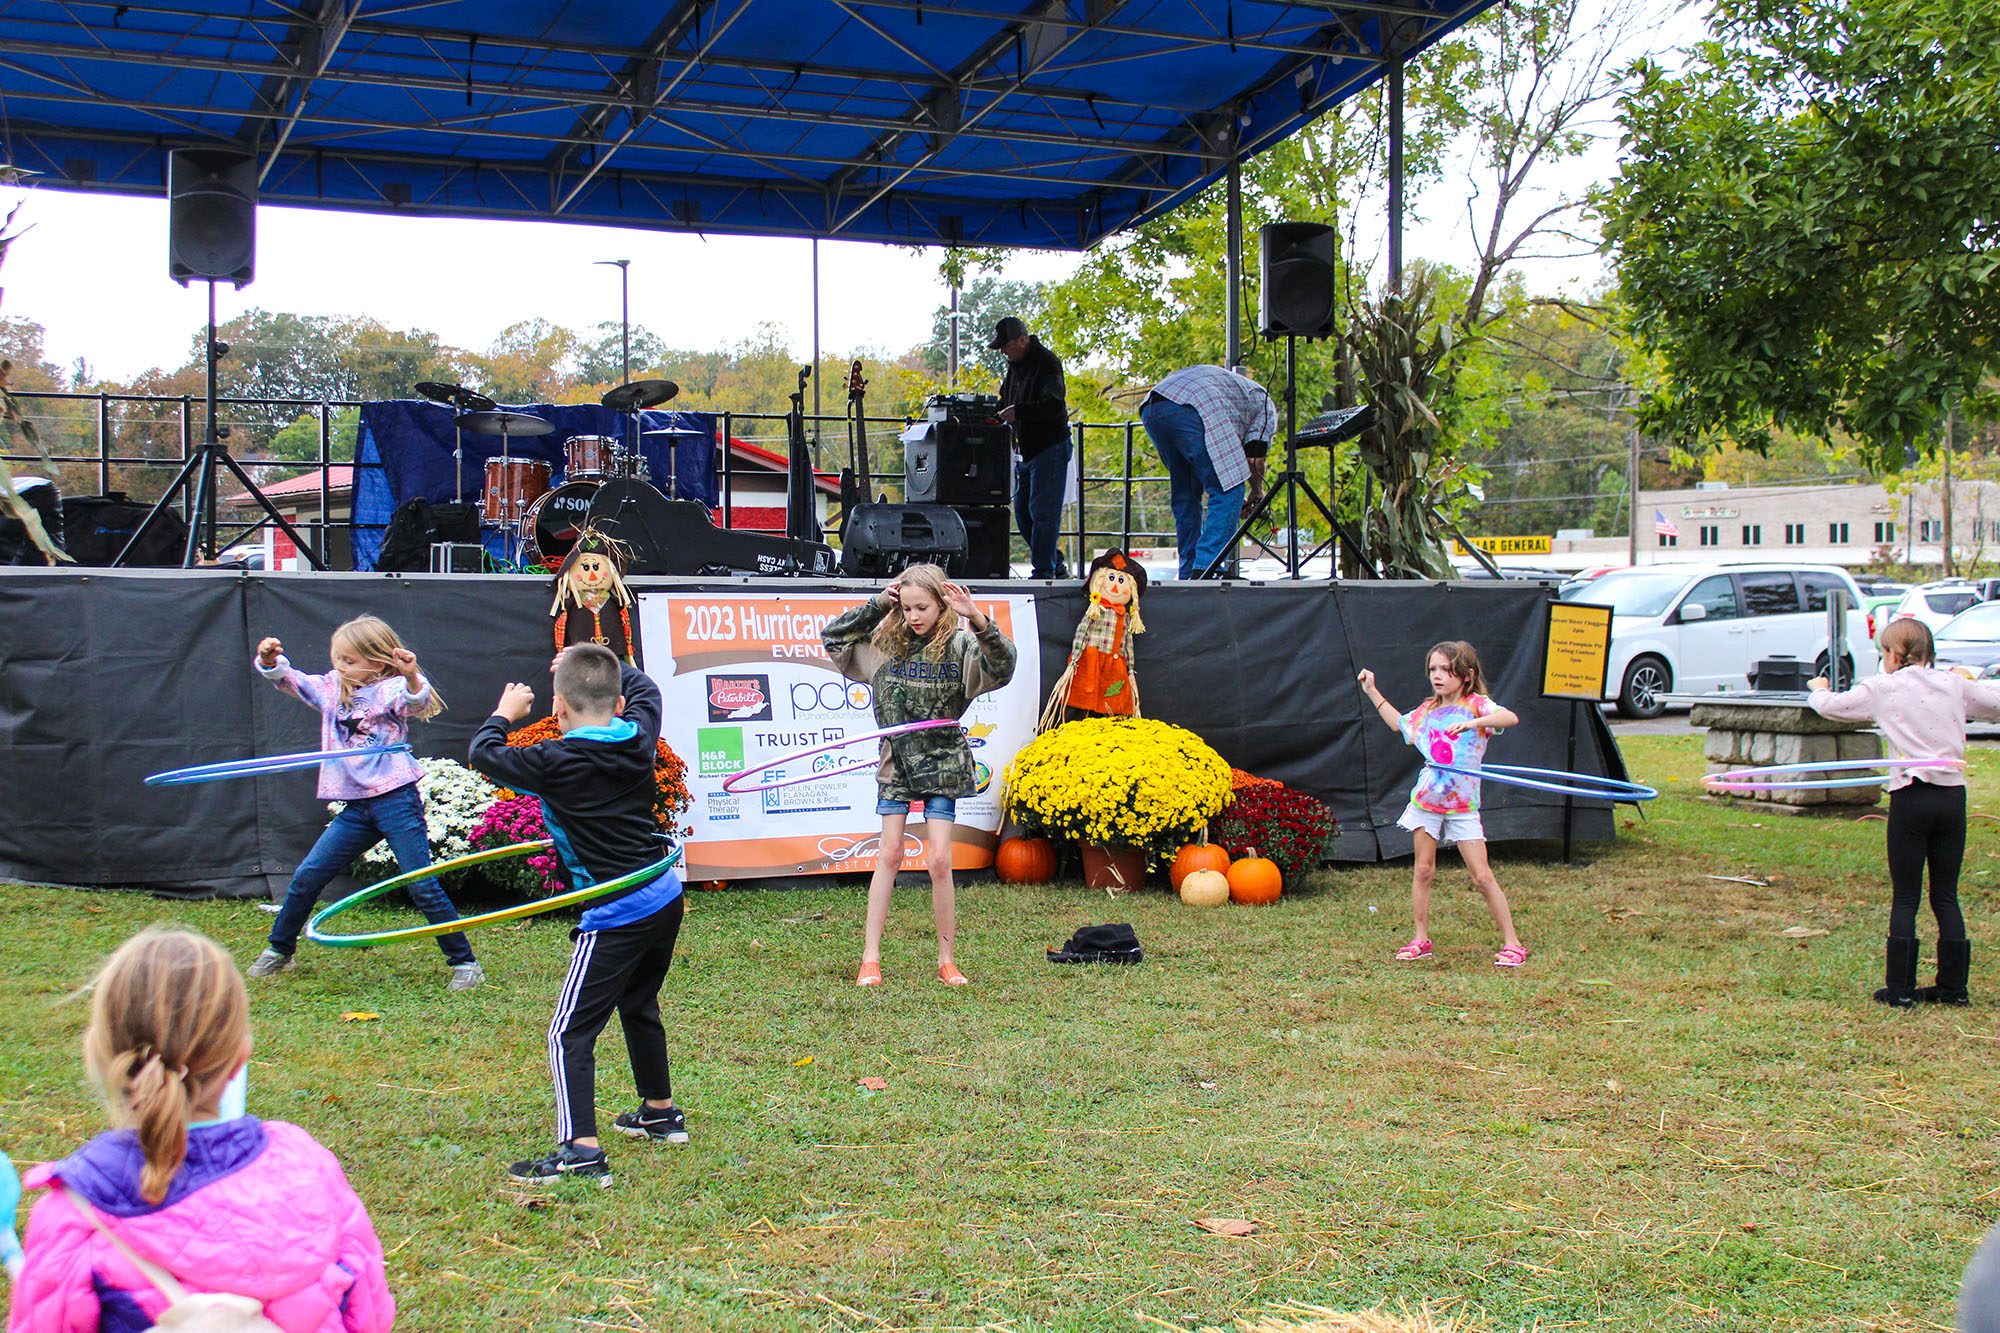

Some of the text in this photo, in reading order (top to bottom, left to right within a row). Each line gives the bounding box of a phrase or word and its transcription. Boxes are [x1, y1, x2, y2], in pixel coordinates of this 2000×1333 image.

[1501, 539, 1547, 552] GENERAL
[757, 554, 776, 565] CASH
[684, 605, 737, 640] 2023
[889, 658, 959, 680] CABELA'S
[717, 691, 759, 704] Peterbilt
[755, 732, 818, 747] TRUIST
[701, 751, 727, 761] H&R
[702, 760, 742, 770] BLOCK
[707, 797, 740, 806] Physical
[709, 805, 740, 813] Therapy
[820, 860, 858, 870] WEST
